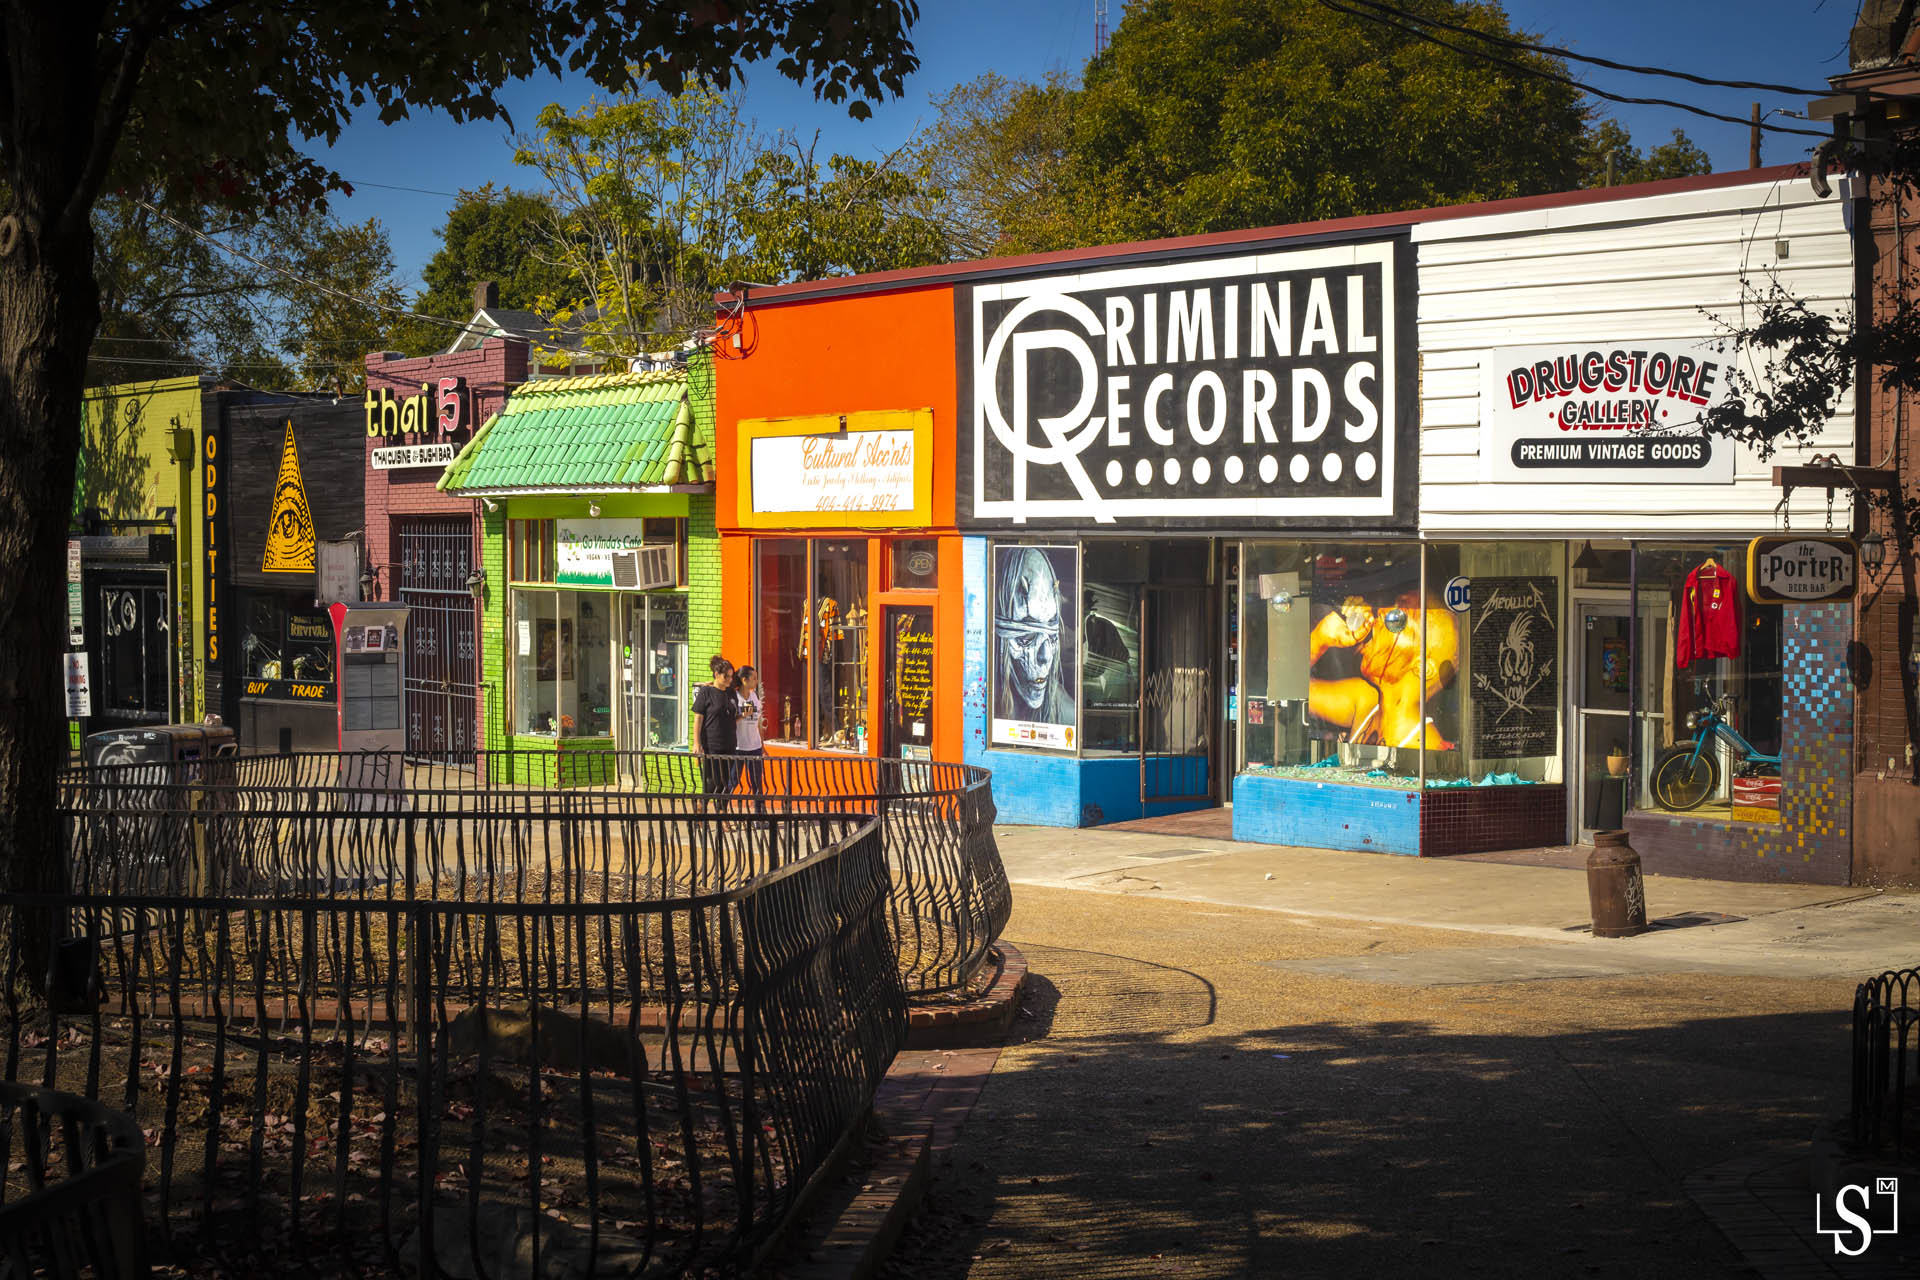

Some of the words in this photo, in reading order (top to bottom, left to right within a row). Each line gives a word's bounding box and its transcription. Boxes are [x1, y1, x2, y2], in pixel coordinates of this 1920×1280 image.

[1507, 350, 1718, 409] DRUGSTORE
[364, 383, 428, 437] thai
[439, 377, 460, 435] 5
[1558, 399, 1660, 431] GALLERY
[374, 452, 388, 465] THAI
[388, 449, 411, 465] CUISINE
[419, 448, 439, 463] SUSHI
[440, 447, 452, 462] BAR
[802, 435, 864, 470] Cultural
[1520, 444, 1582, 460] PREMIUM
[1588, 444, 1645, 460] VINTAGE
[1651, 443, 1702, 460] GOODS
[206, 435, 218, 660] ODDITIES
[1799, 544, 1815, 556] the
[1788, 584, 1808, 593] BEER
[1810, 584, 1826, 593] BAR
[247, 682, 269, 695] BUY
[292, 684, 325, 698] TRADE
